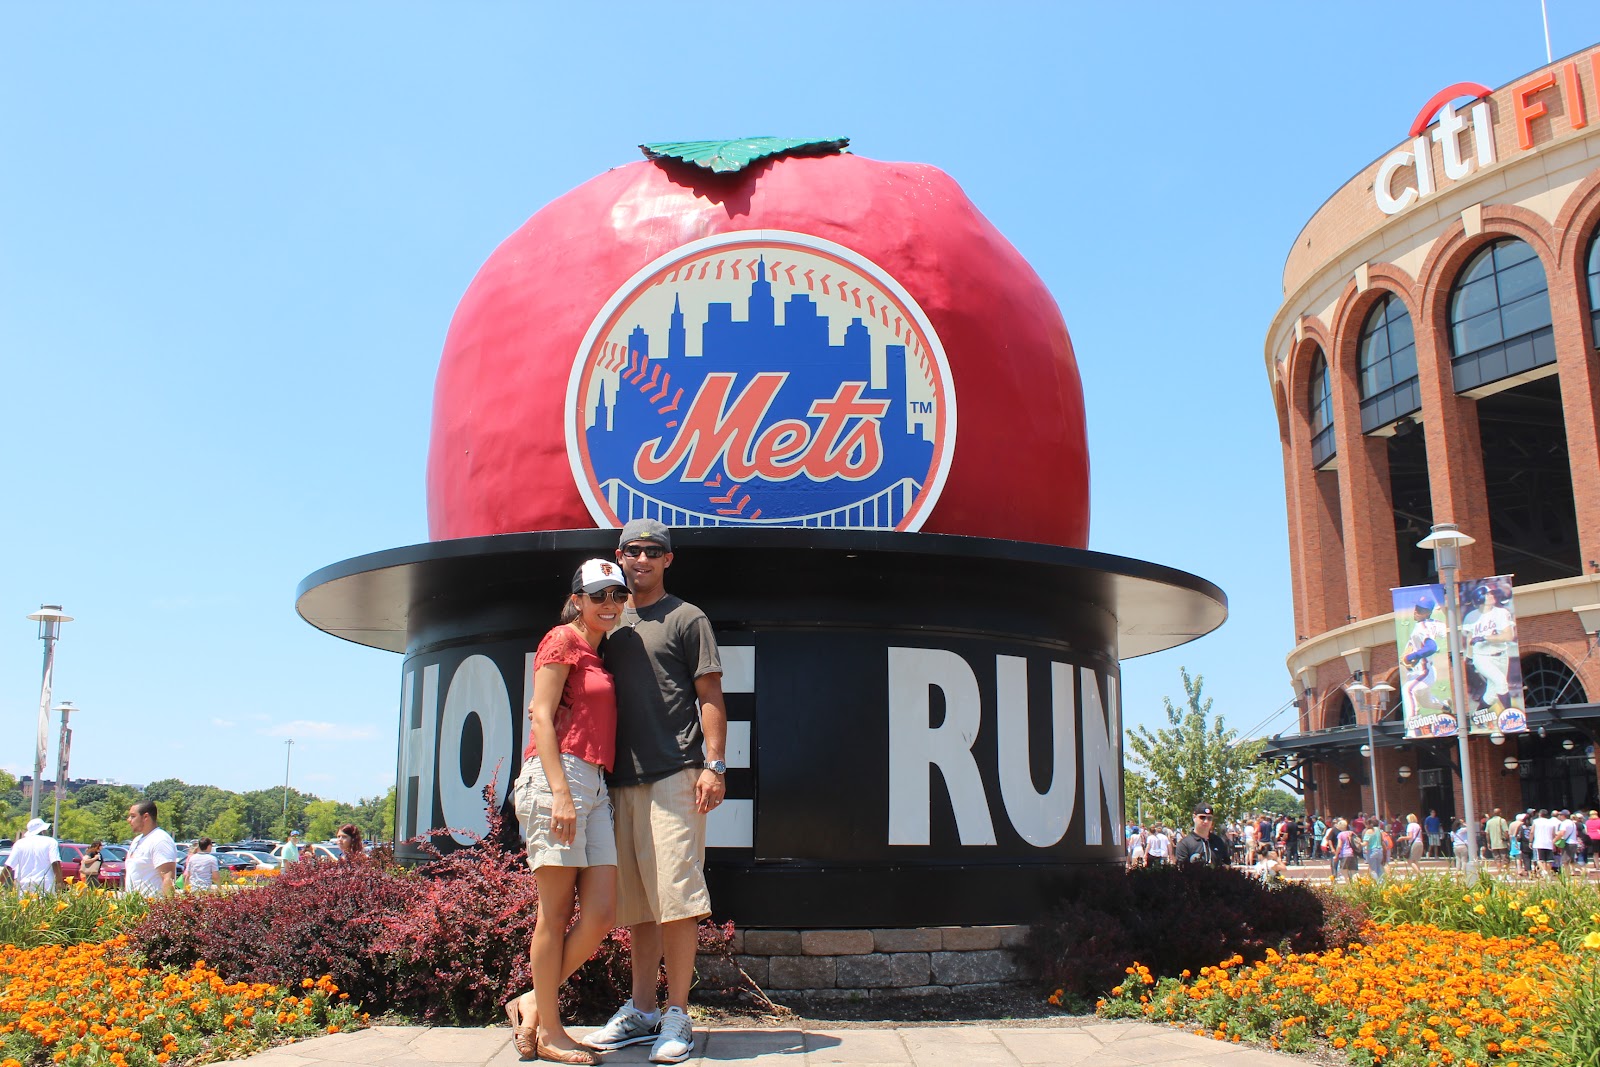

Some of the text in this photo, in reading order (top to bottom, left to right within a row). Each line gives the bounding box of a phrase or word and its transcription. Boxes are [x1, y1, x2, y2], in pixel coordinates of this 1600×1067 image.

[909, 401, 932, 414] TM
[633, 371, 892, 484] Mets
[1408, 713, 1440, 730] GOODEN
[1472, 711, 1498, 725] STAUB
[400, 645, 1122, 848] HOE RUN
